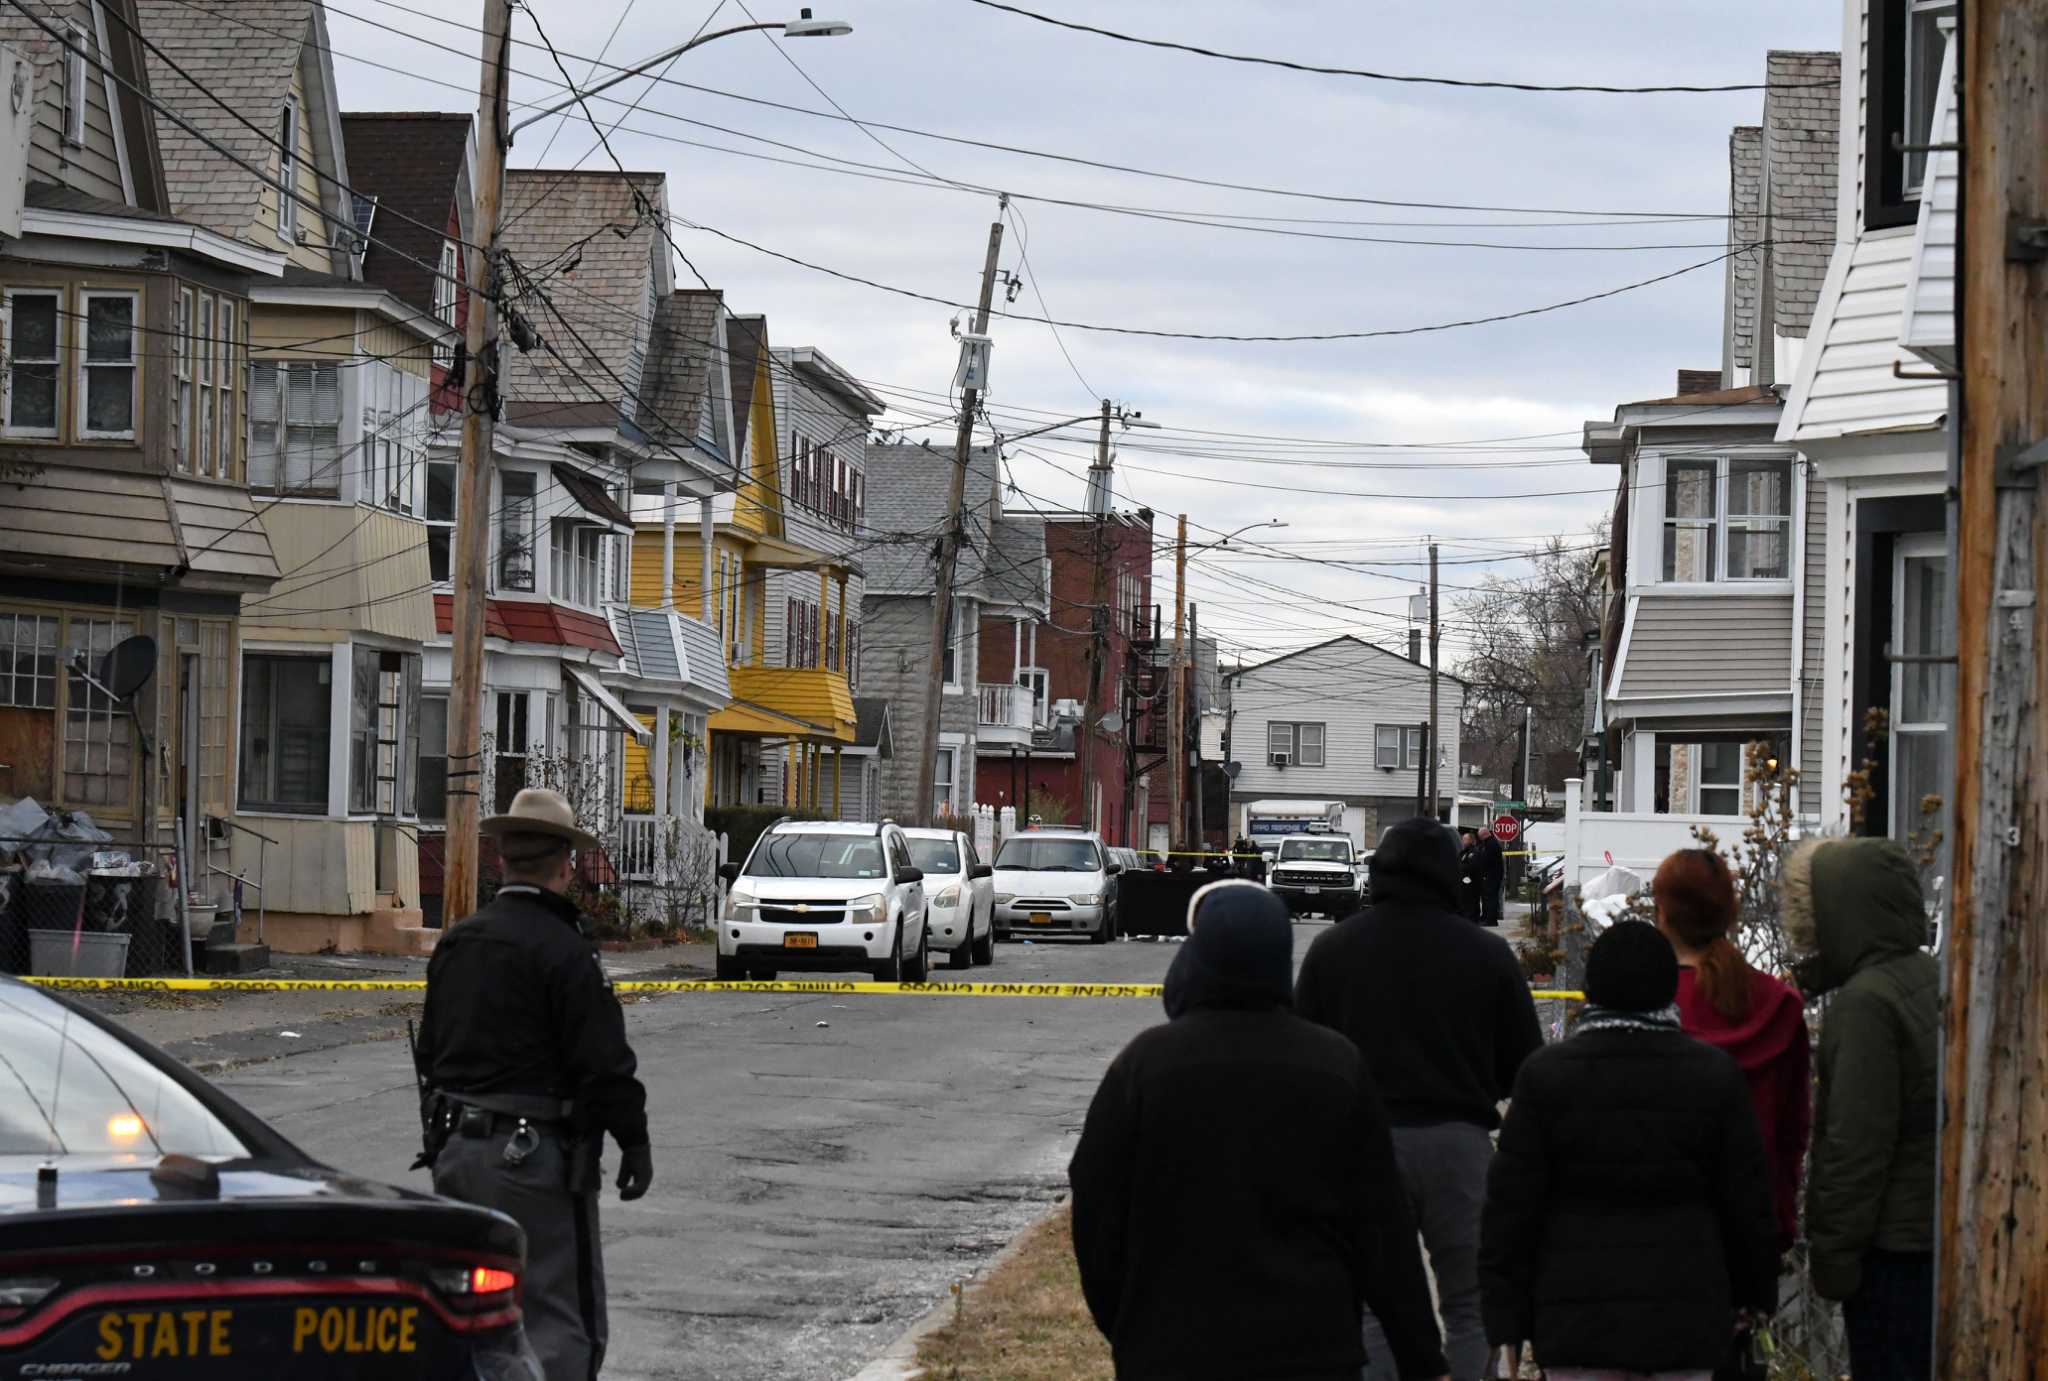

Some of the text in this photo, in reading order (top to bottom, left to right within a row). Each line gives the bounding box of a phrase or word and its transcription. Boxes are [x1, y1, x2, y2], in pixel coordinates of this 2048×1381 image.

[1494, 823, 1517, 833] STOP
[2007, 827, 2020, 846] 3
[133, 1260, 376, 1277] DODGE
[96, 1302, 418, 1361] STATE POLICE
